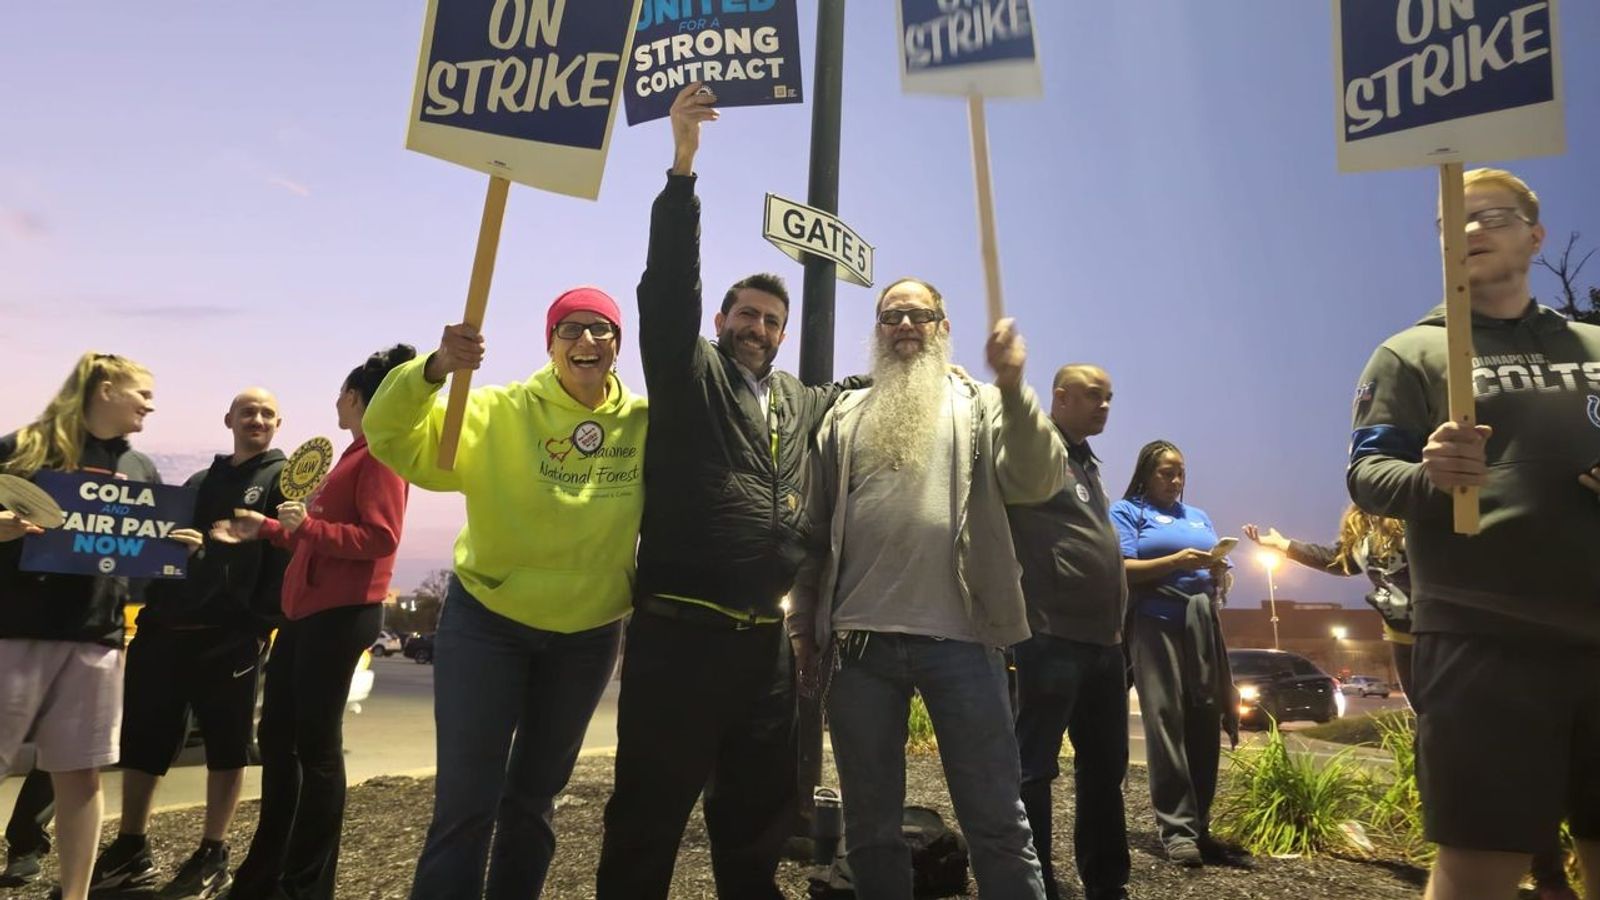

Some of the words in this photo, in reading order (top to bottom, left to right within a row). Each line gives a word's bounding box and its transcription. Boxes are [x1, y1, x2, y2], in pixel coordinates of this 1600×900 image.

[489, 0, 565, 49] ON
[678, 20, 707, 33] FOR
[711, 17, 721, 29] A
[906, 0, 1031, 66] STRIKE
[634, 26, 779, 72] STRONG
[1345, 1, 1550, 134] STRIKE
[425, 52, 621, 116] STRIKE
[635, 57, 784, 97] CONTRACT
[783, 209, 853, 263] GATE
[857, 245, 866, 272] 5
[1472, 362, 1600, 398] COLTS
[540, 461, 593, 484] National
[596, 464, 638, 484] Forest
[79, 481, 156, 507] COLA
[101, 504, 130, 515] AND
[73, 533, 144, 556] NOW
[121, 517, 175, 538] PAY
